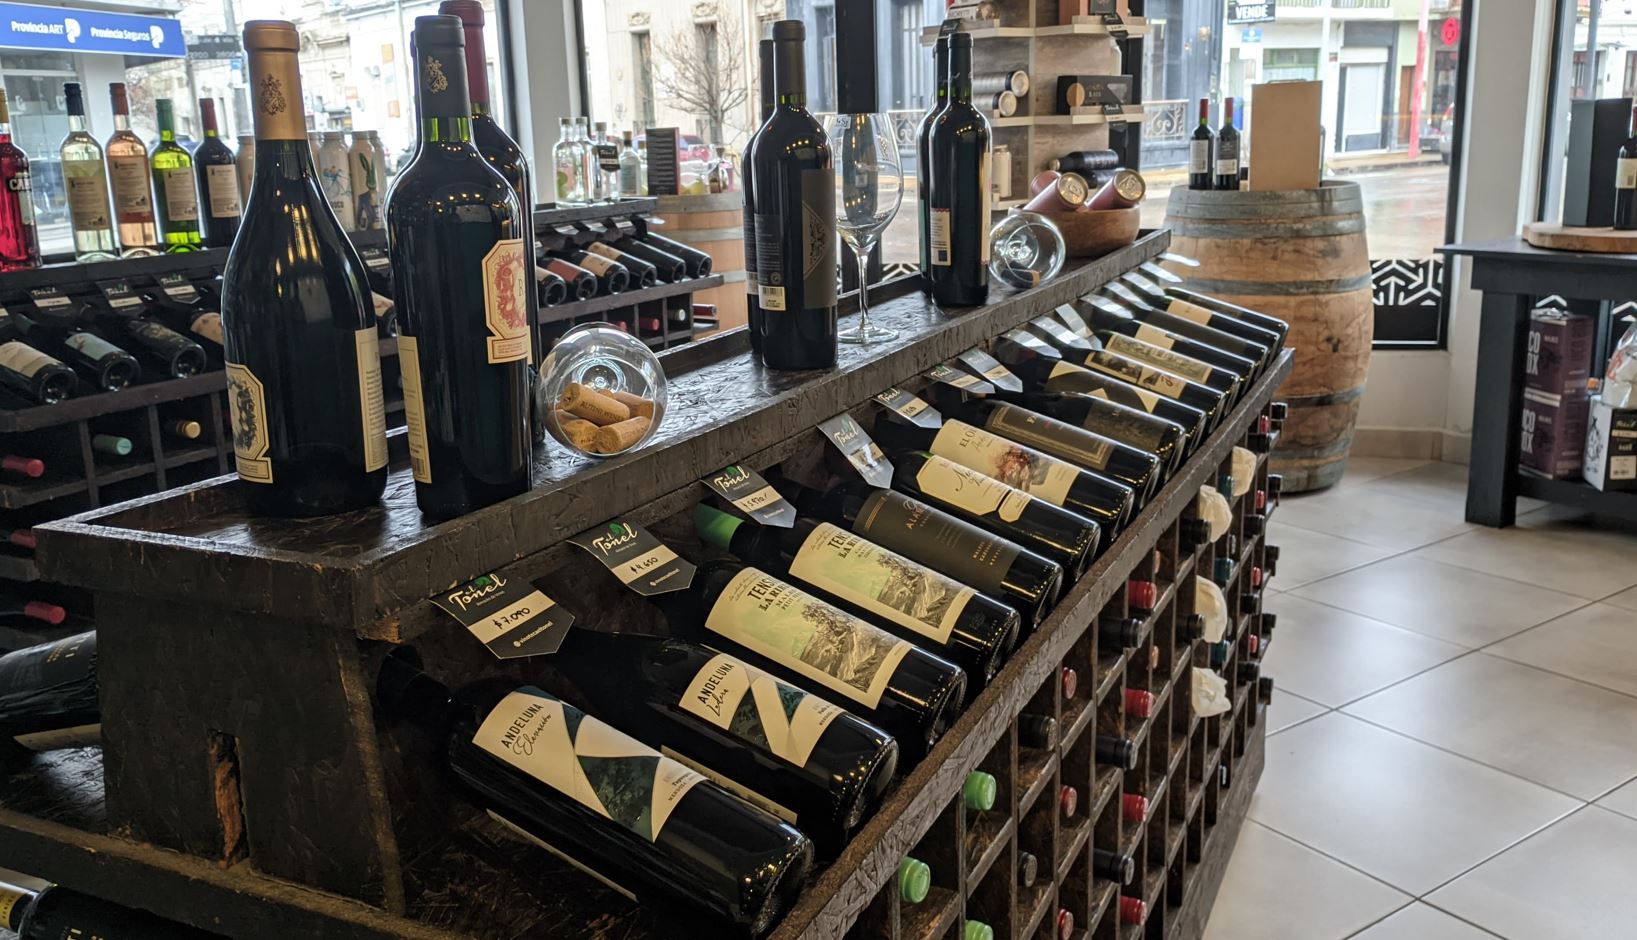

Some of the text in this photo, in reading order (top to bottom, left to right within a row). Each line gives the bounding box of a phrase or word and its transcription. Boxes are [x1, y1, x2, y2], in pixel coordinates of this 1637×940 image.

[11, 21, 64, 34] Provincia ART
[1235, 4, 1268, 19] VENDE
[90, 27, 150, 41] Provincia Seguros
[592, 522, 638, 556] Tonel
[448, 573, 507, 612] Tonel
[697, 662, 735, 705] ANDELUNA
[501, 702, 545, 749] ANDELUNA
